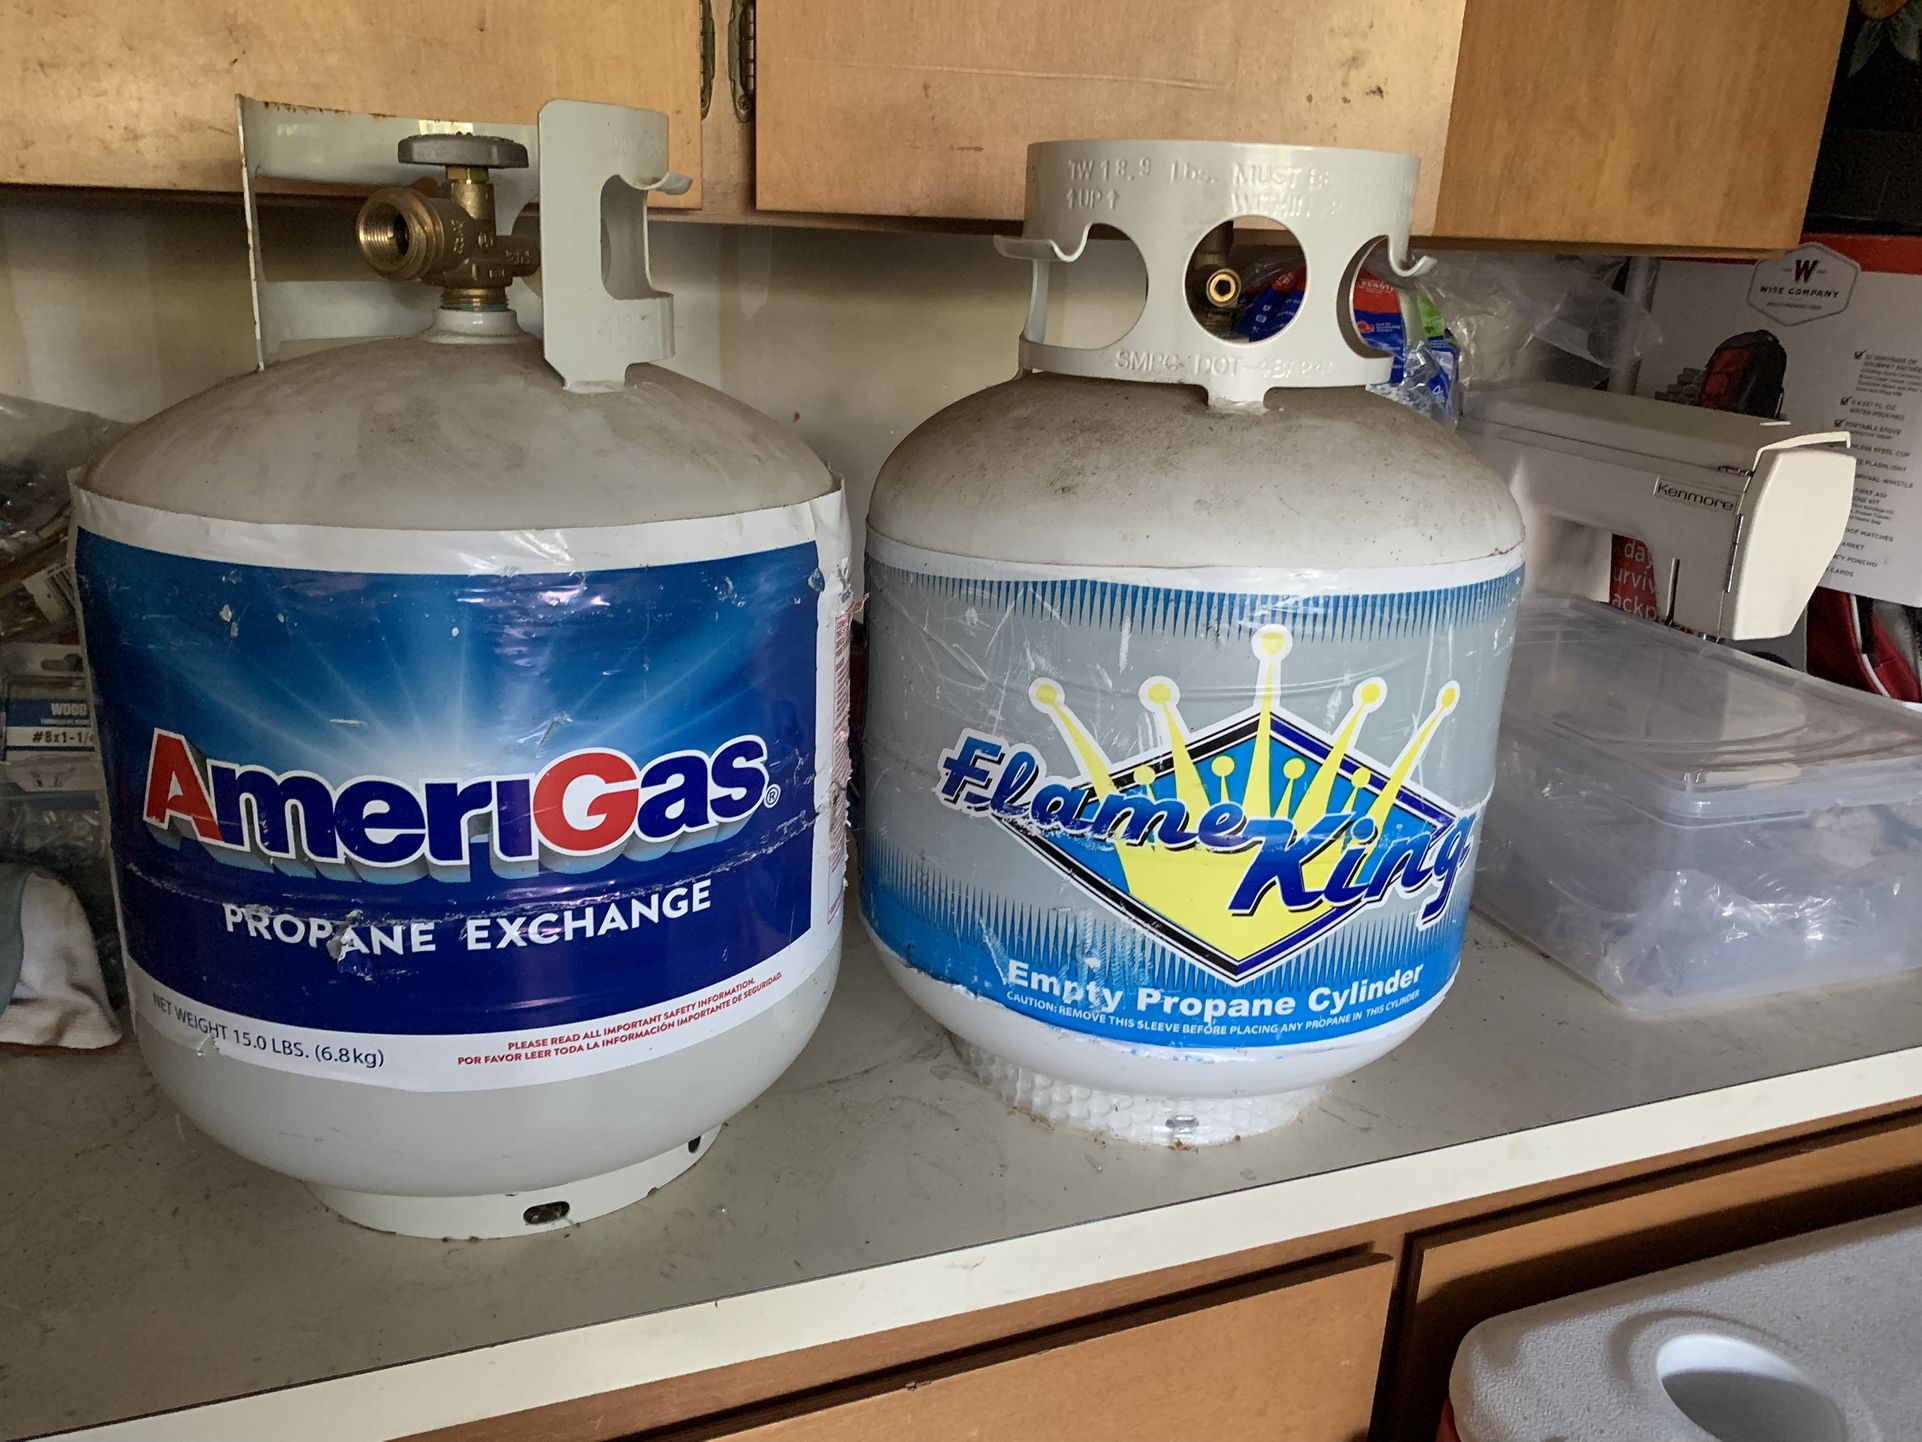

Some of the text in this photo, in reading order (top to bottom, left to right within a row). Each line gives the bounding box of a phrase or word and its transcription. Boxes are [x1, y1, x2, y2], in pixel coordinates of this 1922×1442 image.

[1232, 162, 1302, 189] MUST
[1760, 286, 1840, 298] WISE COMPANY
[1794, 259, 1819, 283] W
[1657, 482, 1734, 512] Kenmore
[1860, 530, 1894, 542] MATCHES
[1830, 567, 1854, 577] CARDS
[1846, 557, 1878, 568] PONCHO
[143, 728, 770, 872] AmeriGas
[939, 732, 1475, 928] Flame King
[223, 878, 713, 955] PROPANE EXCHANGE
[507, 977, 755, 1051] PLEASE READ ALL IMPORTANT SAFETY INFORMATION.
[1006, 989, 1420, 1036] CAUTION: REMOVE THIS SLEEVE BEFORE PLACING ANY PROPANE IN THIS CYLINDER
[1008, 959, 1425, 1024] Empty Propane Cylinder
[153, 992, 173, 1016] NET
[175, 1007, 228, 1041] WEIGHT
[233, 1028, 267, 1051] 15.0
[272, 1037, 309, 1058] LBS.
[457, 1056, 482, 1065] POR
[485, 1053, 522, 1065] FAVOR
[524, 1048, 552, 1061] LEER
[554, 1044, 584, 1057] TODA
[586, 1041, 600, 1050] LA
[602, 1019, 675, 1047] INFORMACIÓN
[676, 998, 731, 1026] IMPORTANTE
[731, 993, 743, 1005] DE
